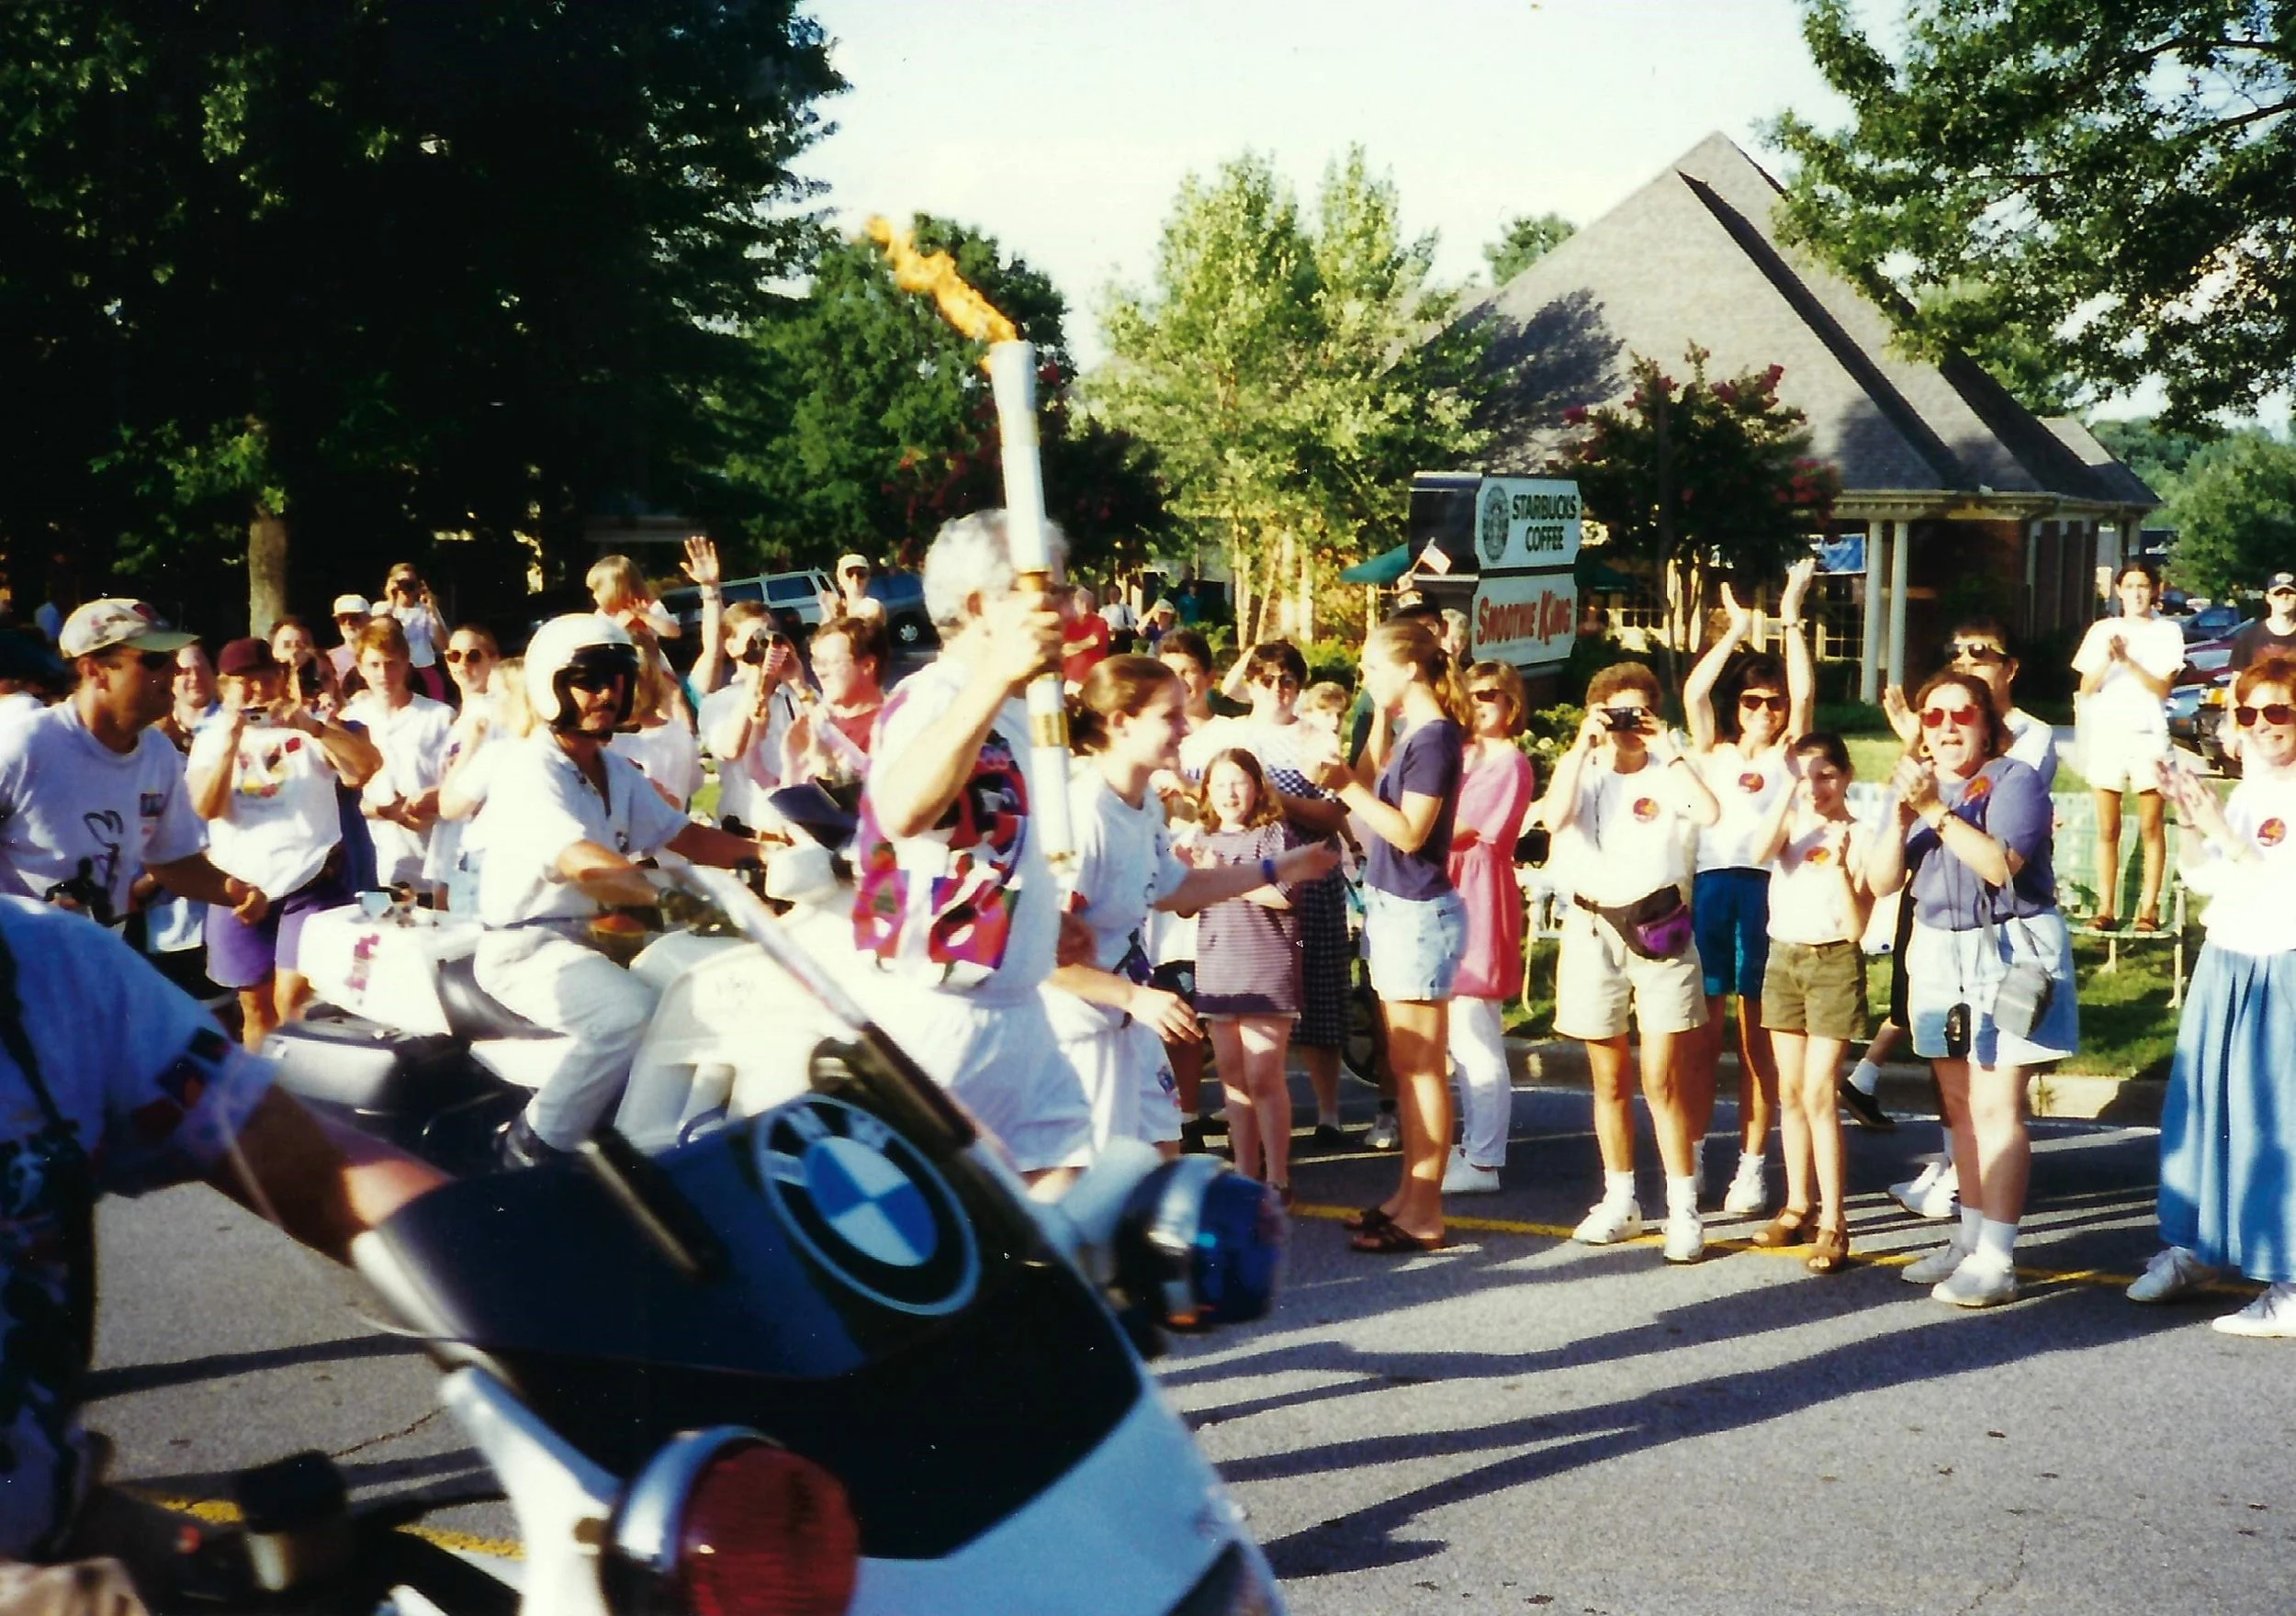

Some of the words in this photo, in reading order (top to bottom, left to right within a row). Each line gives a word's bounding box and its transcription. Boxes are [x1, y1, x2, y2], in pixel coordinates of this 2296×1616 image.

[1512, 495, 1577, 520] STARBUCKS
[1526, 526, 1564, 552] COFFEE
[762, 1105, 889, 1186] BMW
